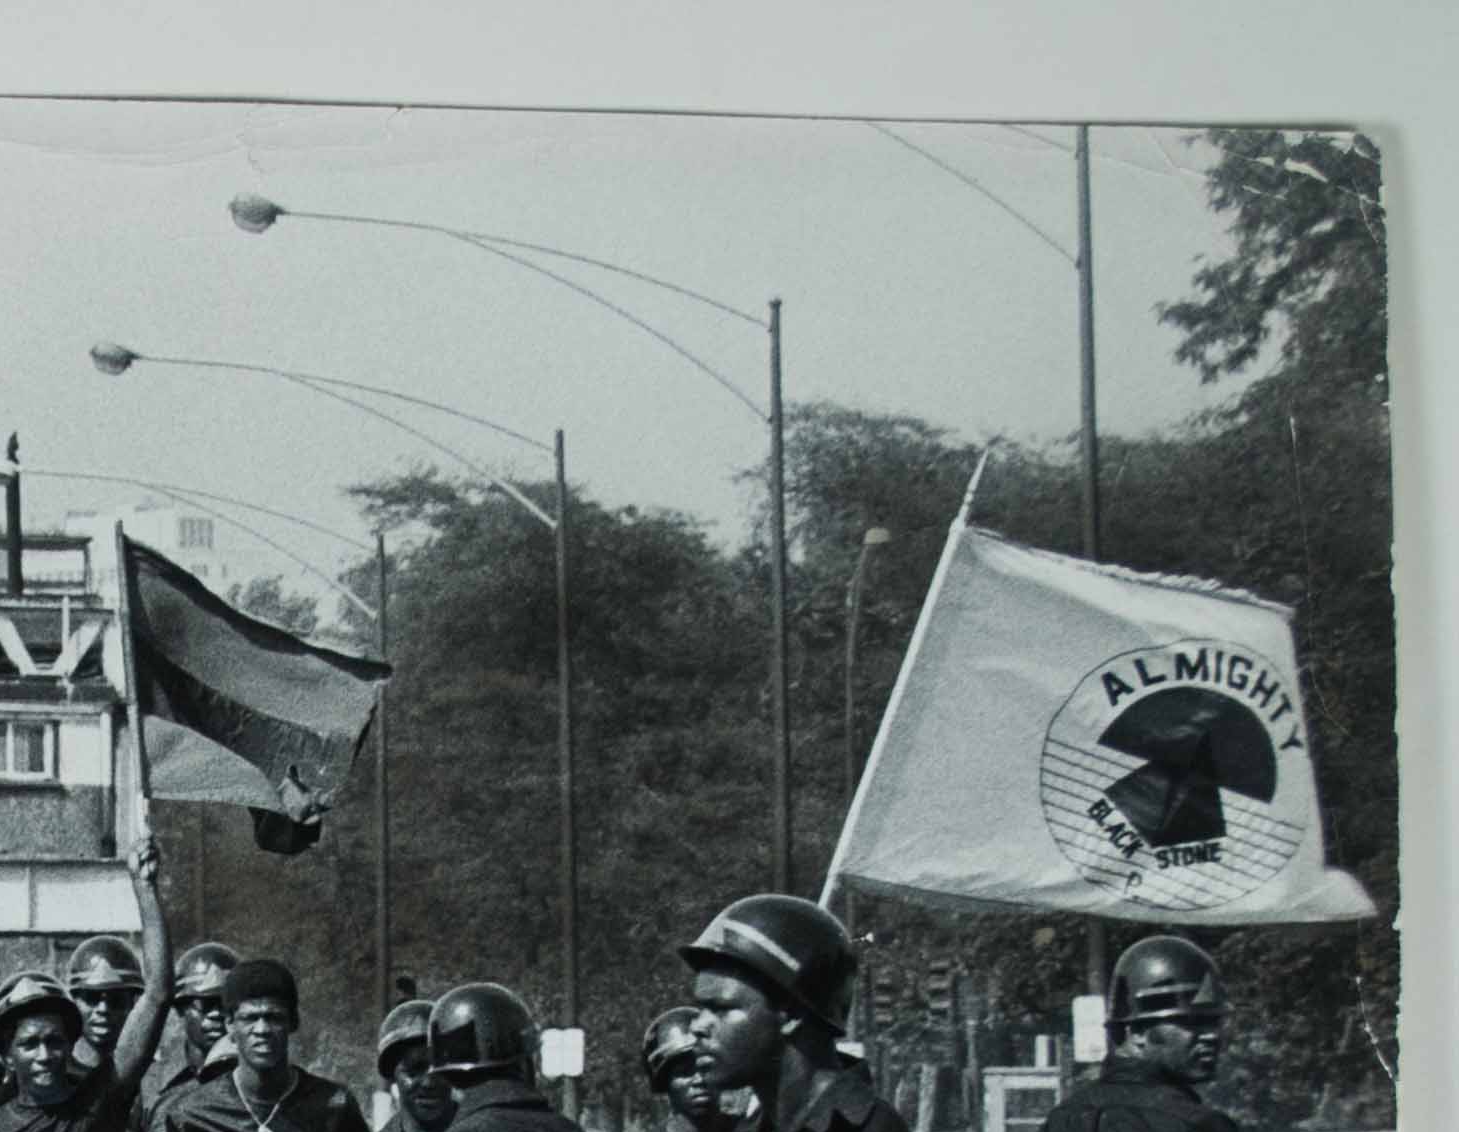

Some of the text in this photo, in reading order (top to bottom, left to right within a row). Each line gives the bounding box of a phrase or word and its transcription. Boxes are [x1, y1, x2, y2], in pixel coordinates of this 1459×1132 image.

[1101, 648, 1303, 750] ALMIGHTY
[1087, 798, 1222, 870] BLACK STONE
